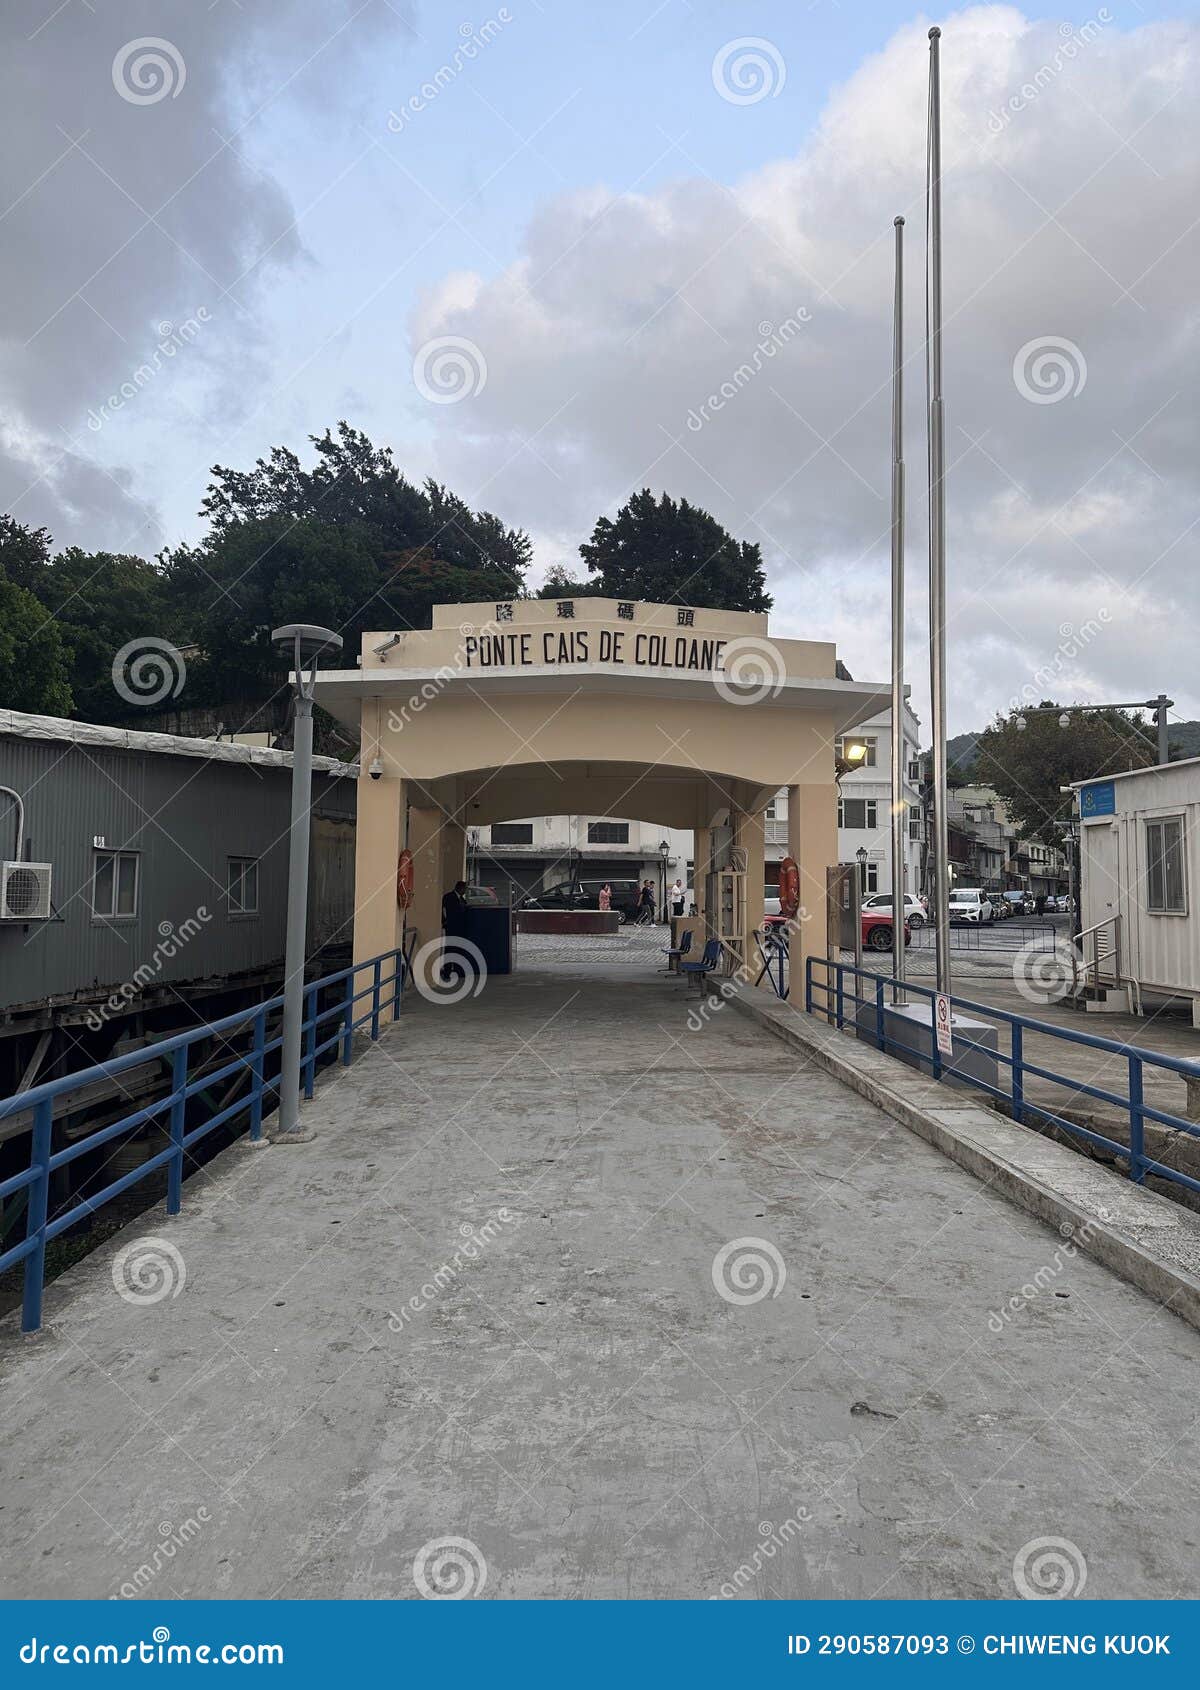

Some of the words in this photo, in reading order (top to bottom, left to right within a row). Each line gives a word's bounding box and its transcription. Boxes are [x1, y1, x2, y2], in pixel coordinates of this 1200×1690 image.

[466, 633, 533, 667] PONTE
[543, 631, 589, 664] CAIS
[599, 630, 625, 663] DE
[635, 634, 728, 672] COLOANE
